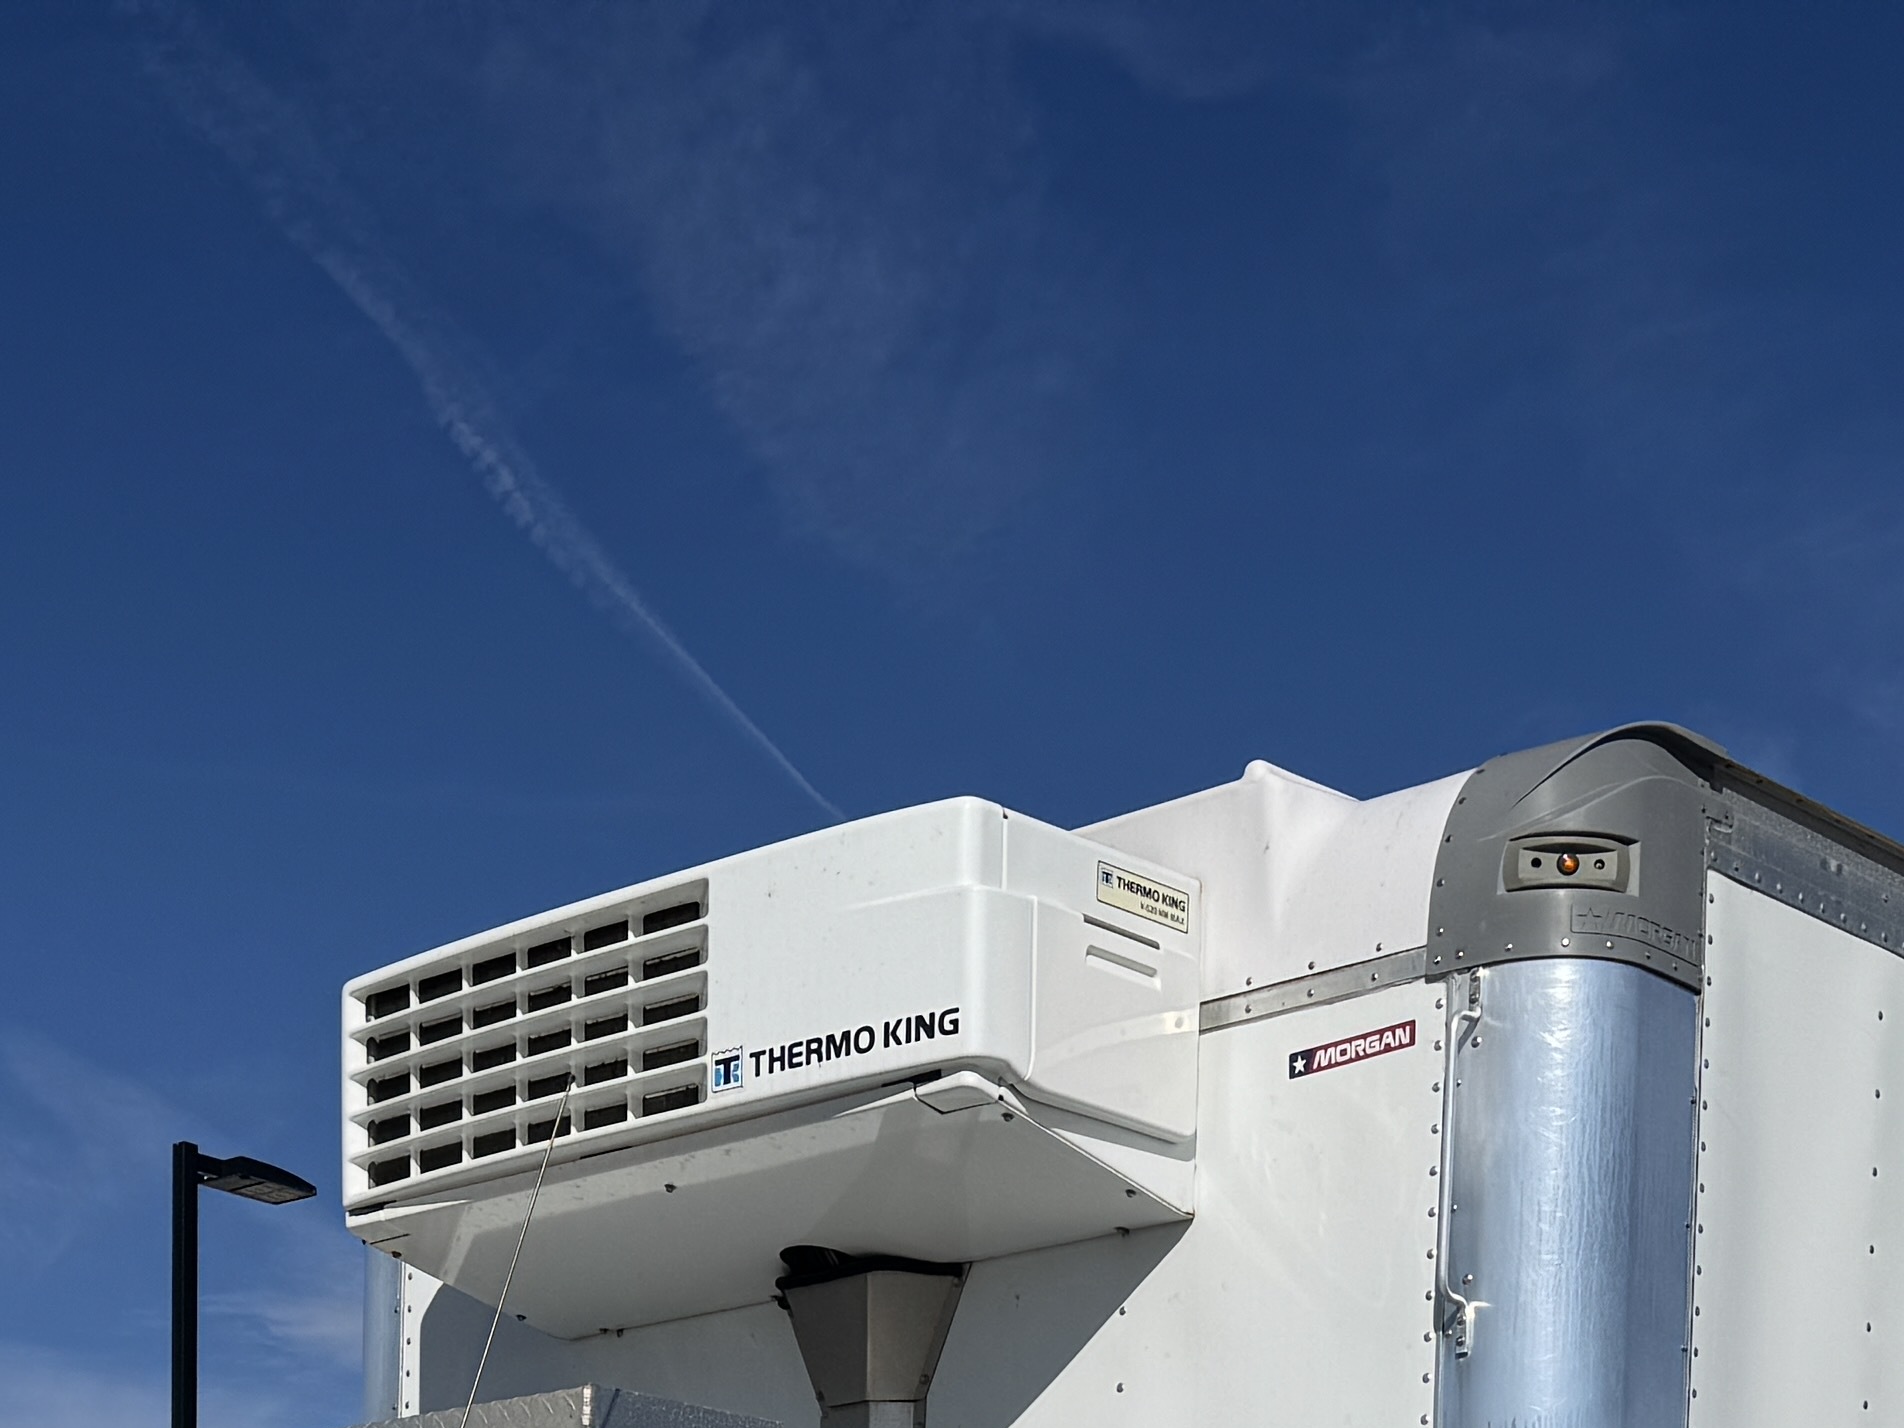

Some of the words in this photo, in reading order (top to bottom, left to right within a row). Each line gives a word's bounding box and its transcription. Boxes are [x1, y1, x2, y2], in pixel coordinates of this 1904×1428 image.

[1116, 876, 1160, 902] THERMO
[1162, 892, 1186, 912] KING
[749, 1026, 875, 1077] THERMO
[883, 1007, 960, 1048] KING
[1312, 1025, 1411, 1070] MORGAN
